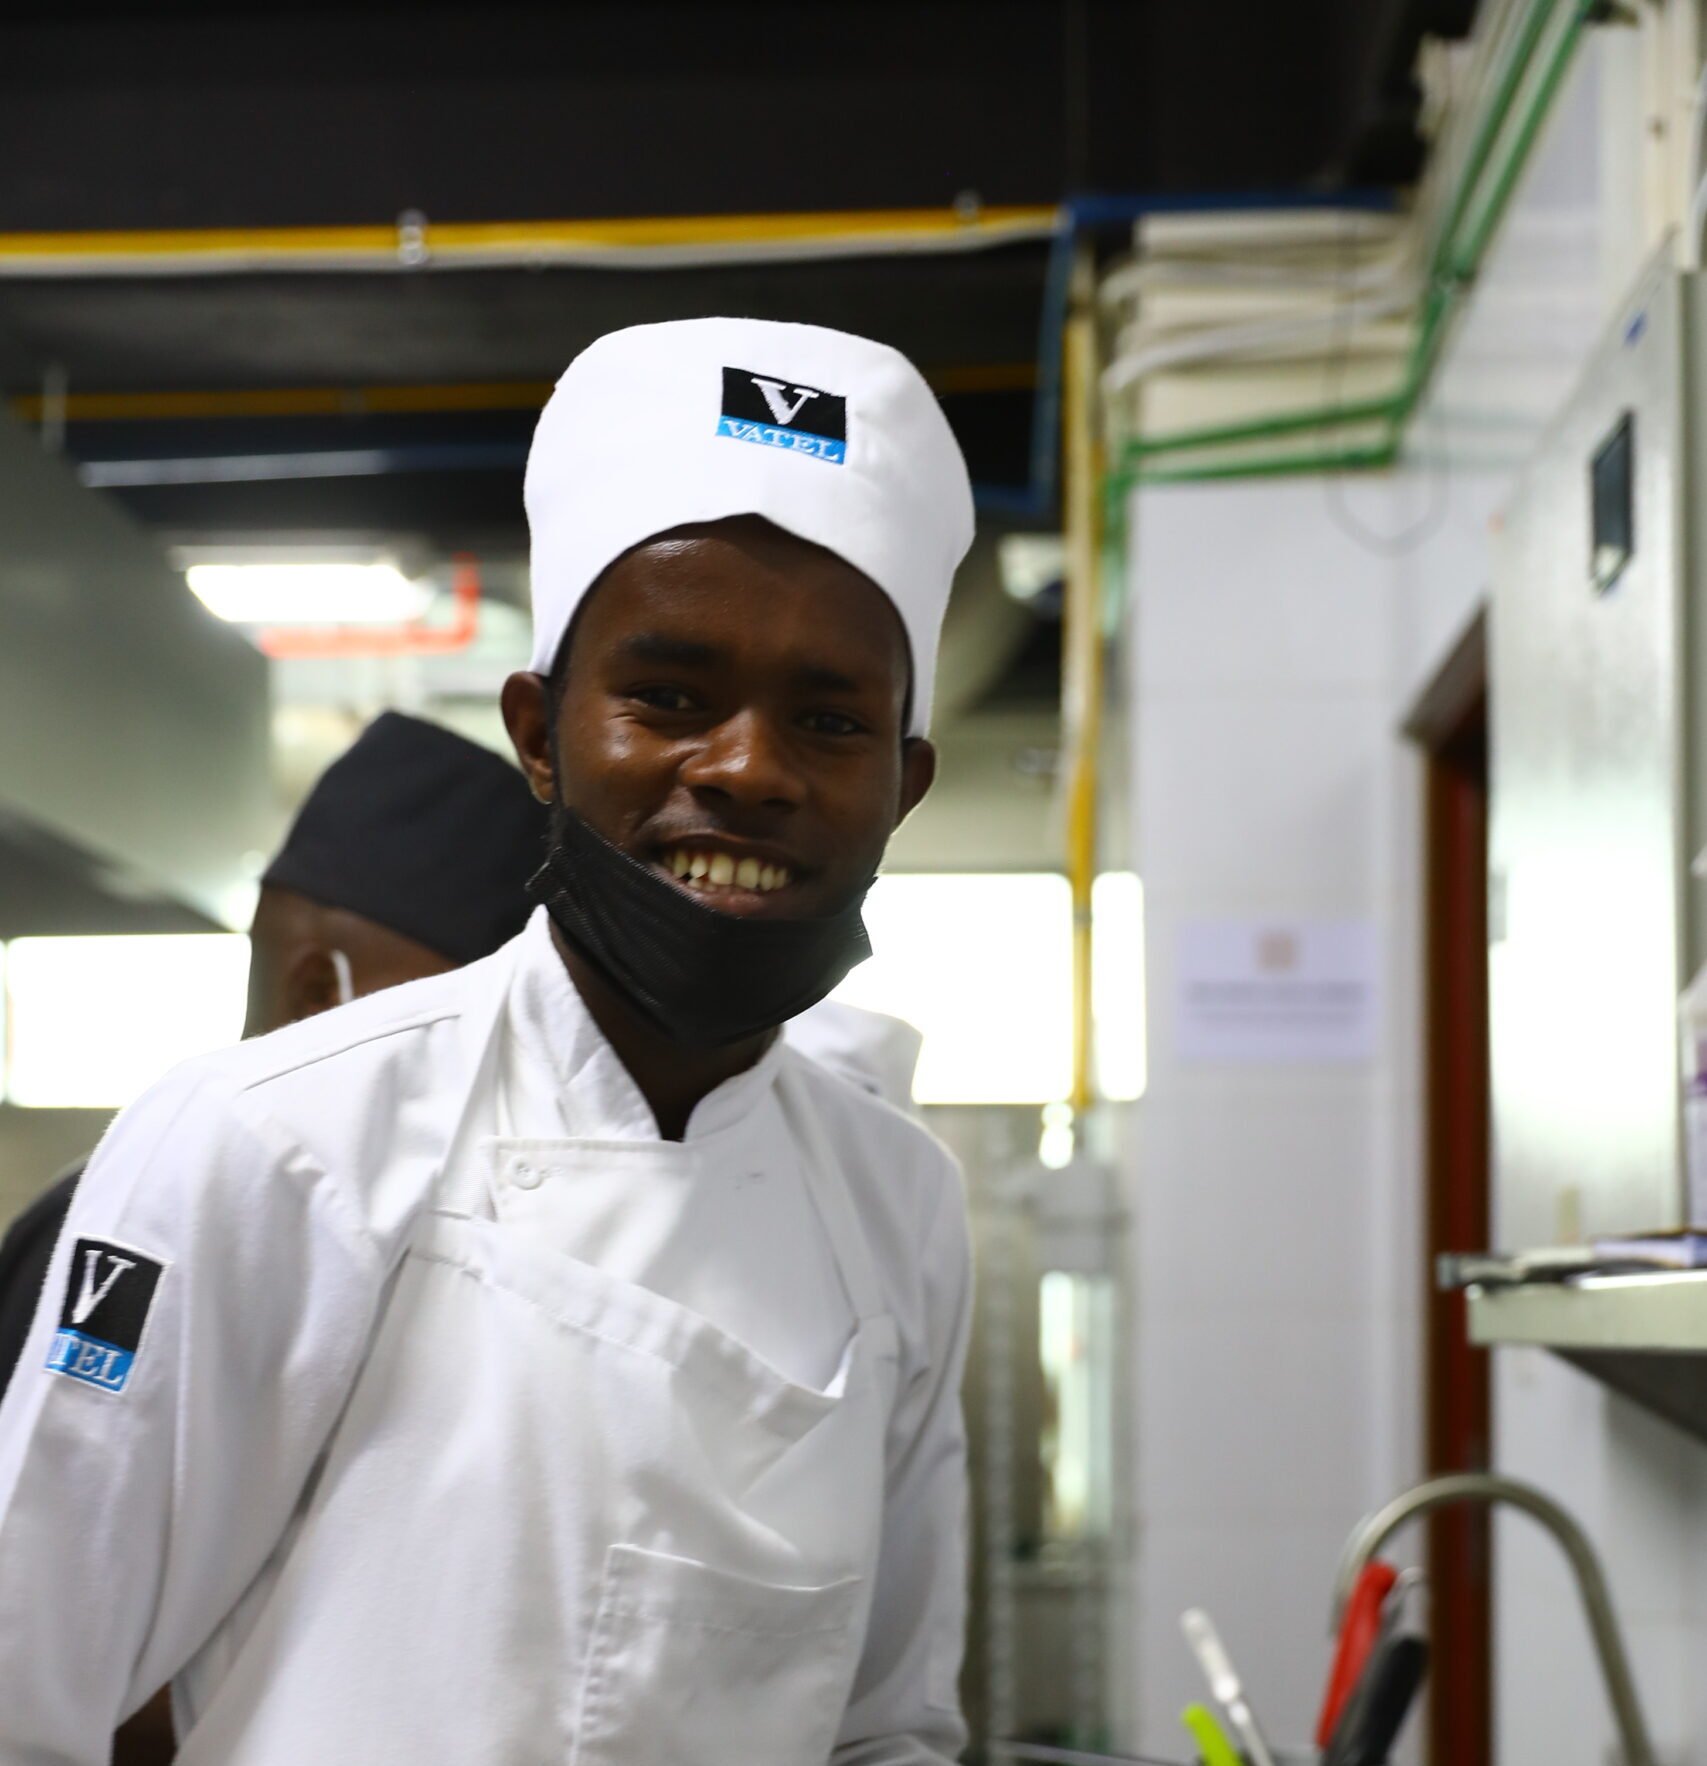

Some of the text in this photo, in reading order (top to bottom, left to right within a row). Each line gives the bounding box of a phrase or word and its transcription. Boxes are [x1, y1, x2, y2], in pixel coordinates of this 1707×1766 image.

[751, 377, 820, 425] V
[723, 420, 840, 462] VATEL
[72, 1249, 137, 1324] V
[47, 1332, 124, 1383] TEL
